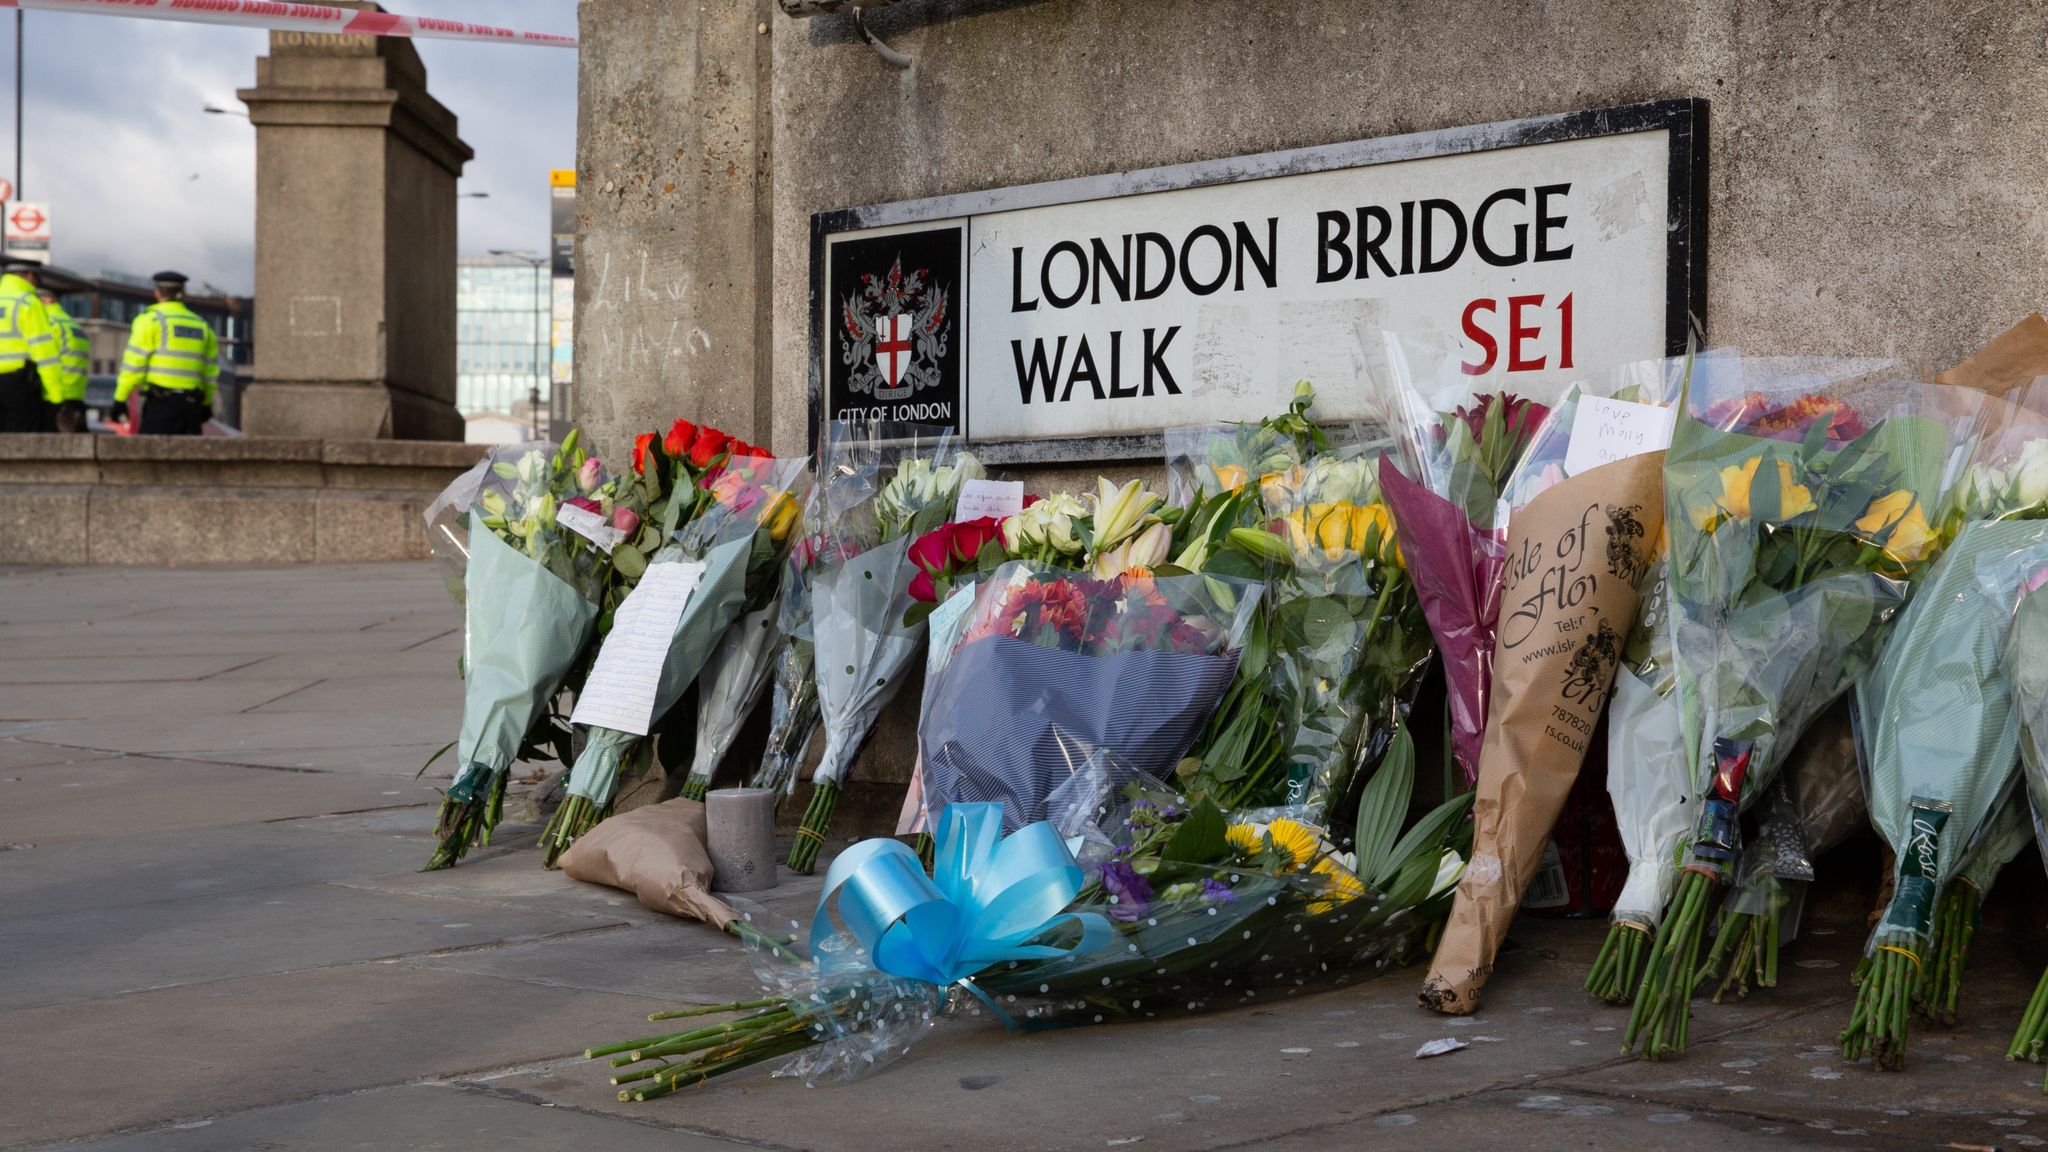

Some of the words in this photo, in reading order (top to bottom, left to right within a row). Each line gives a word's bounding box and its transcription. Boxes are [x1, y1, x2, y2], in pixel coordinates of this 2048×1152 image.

[1011, 217, 1279, 313] LONDON
[1316, 182, 1574, 284] BRIDGE
[1010, 326, 1183, 405] WALK
[1461, 291, 1574, 376] SE1
[878, 389, 908, 398] DIRIGE
[838, 407, 868, 424] CITY
[870, 406, 888, 422] OF
[893, 401, 951, 421] LONDON
[1594, 399, 1631, 425] Love
[1599, 422, 1644, 445] Molly
[1599, 448, 1630, 462] an
[1557, 503, 1599, 572] of
[1552, 705, 1590, 736] 787820
